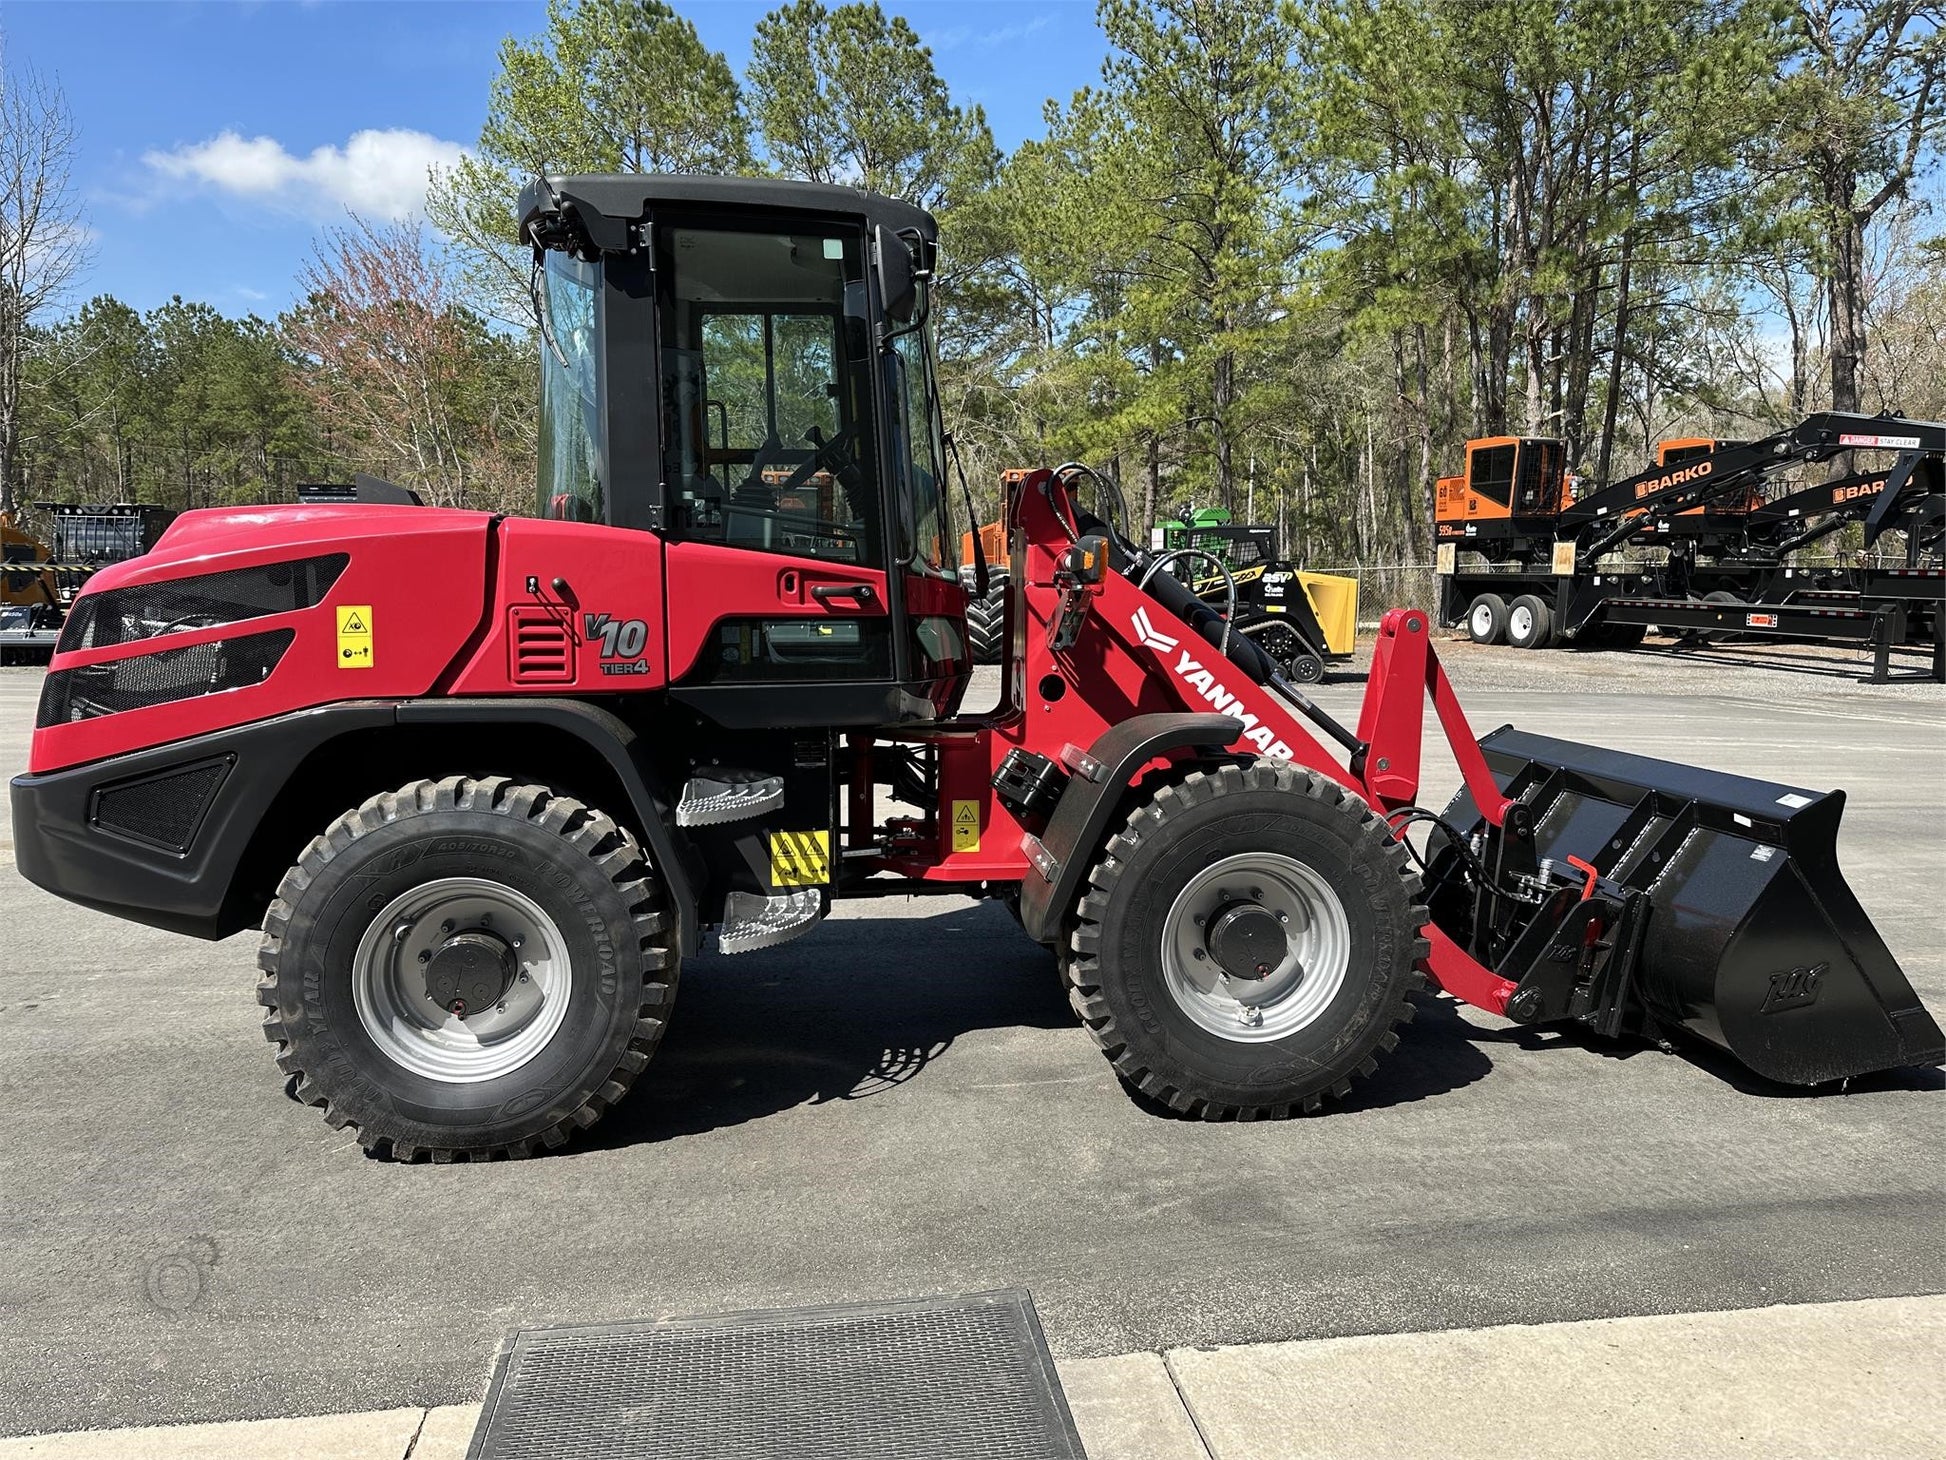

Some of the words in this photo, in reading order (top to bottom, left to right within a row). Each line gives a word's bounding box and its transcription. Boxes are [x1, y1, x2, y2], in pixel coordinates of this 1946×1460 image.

[1879, 438, 1894, 446] STAY
[1895, 438, 1917, 446] CLEAR
[1648, 461, 1713, 493] BARKO
[584, 612, 648, 659] V10
[600, 658, 650, 675] TIER4
